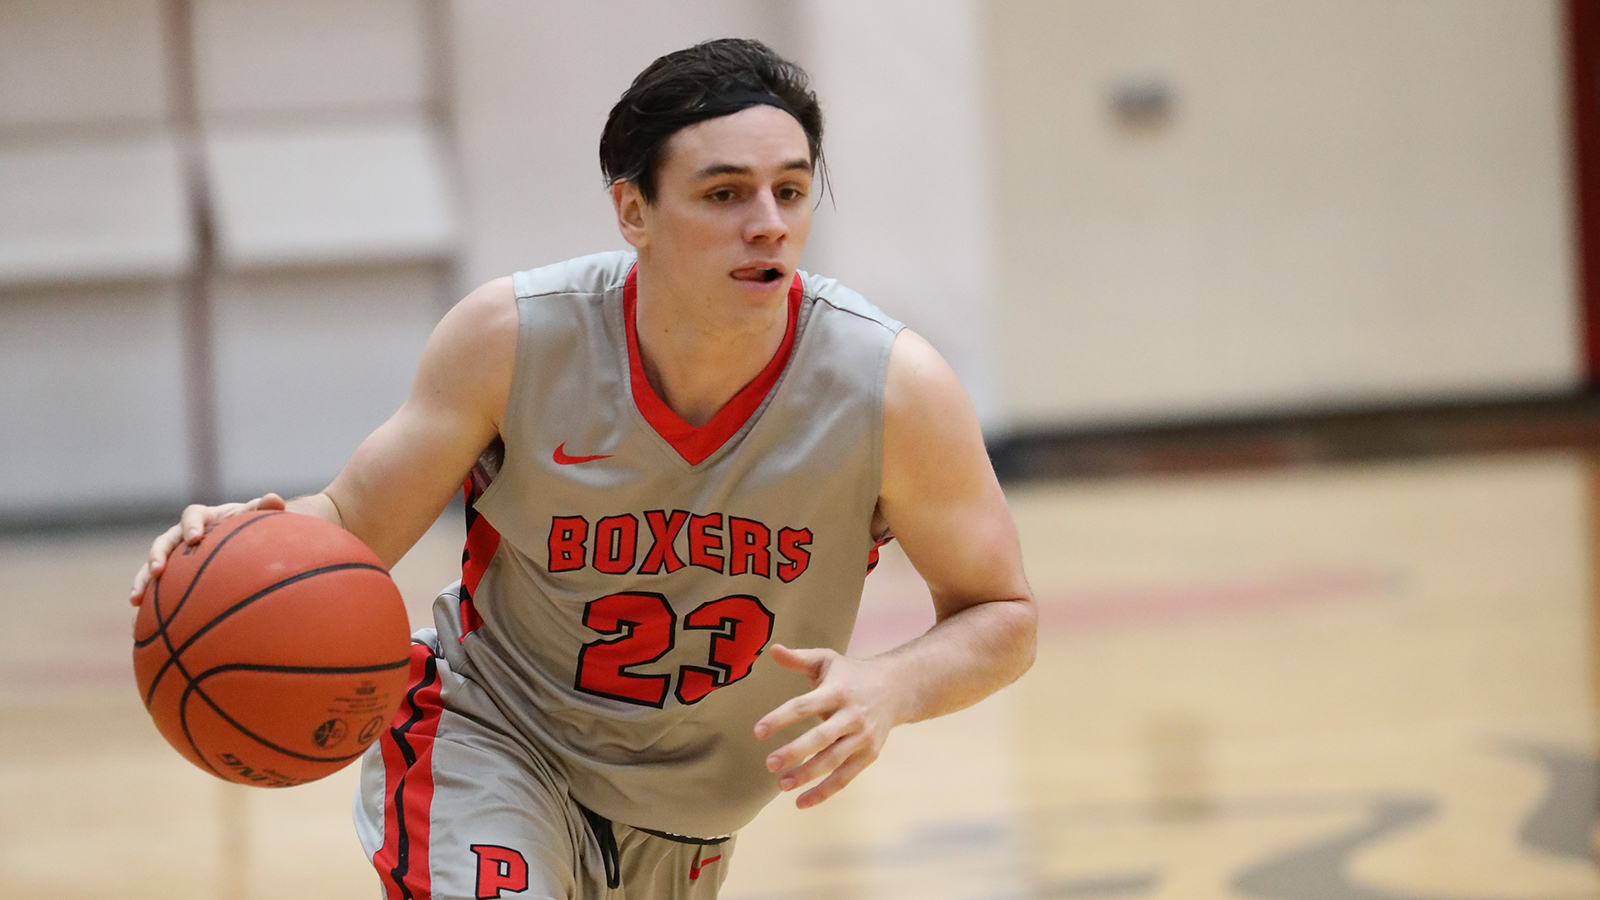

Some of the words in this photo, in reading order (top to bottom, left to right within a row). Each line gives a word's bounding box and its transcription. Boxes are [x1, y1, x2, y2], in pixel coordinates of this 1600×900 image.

[548, 509, 813, 583] BOXERS
[574, 591, 775, 709] 23
[470, 844, 529, 900] P
